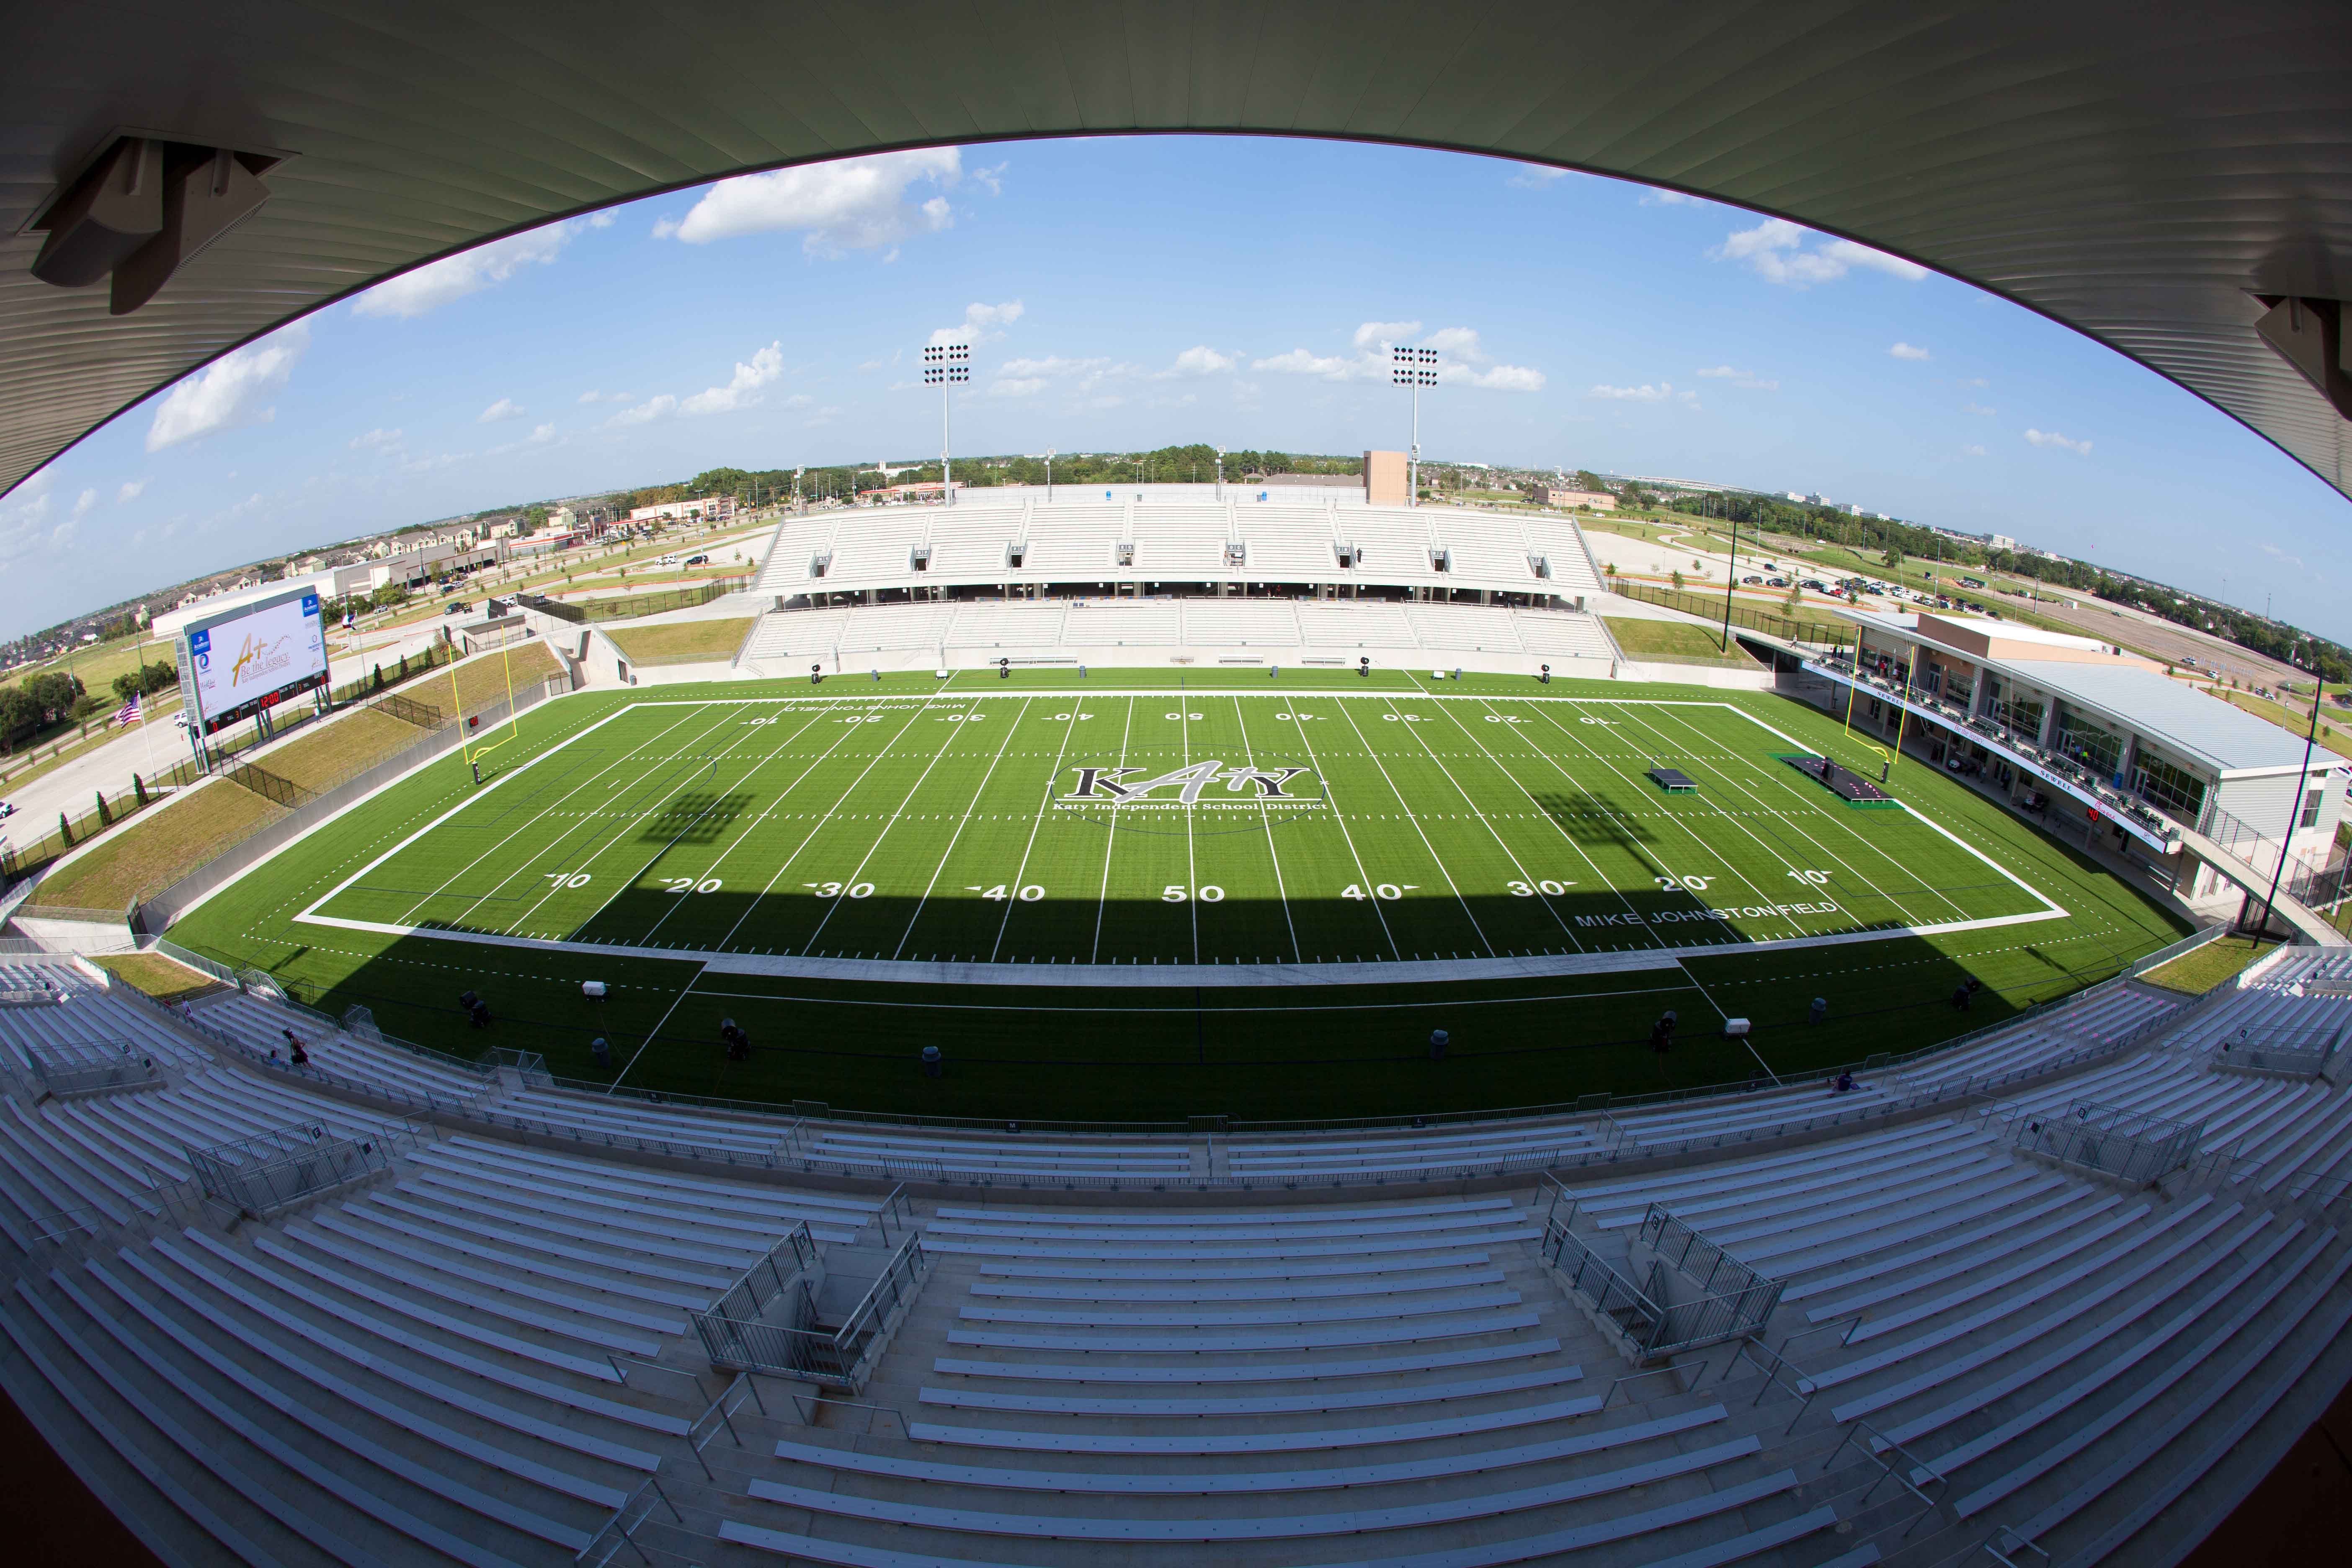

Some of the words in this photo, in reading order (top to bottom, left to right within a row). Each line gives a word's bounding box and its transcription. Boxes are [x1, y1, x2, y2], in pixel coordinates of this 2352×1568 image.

[241, 665, 250, 677] Be
[253, 660, 264, 672] the
[261, 691, 279, 707] 12:00
[1877, 691, 1903, 706] SEWELL
[746, 717, 779, 725] 10
[2040, 770, 2071, 792] SEWELL
[2088, 807, 2099, 821] 40
[551, 873, 591, 888] 10
[1654, 875, 1707, 891] 20
[1787, 870, 1828, 885] 10
[665, 878, 723, 894] 20
[815, 882, 875, 899] 30
[982, 885, 1046, 902] 40
[1161, 885, 1225, 903] 50
[1340, 884, 1402, 901] 40
[1507, 879, 1567, 897] 30
[1575, 913, 1644, 926] MIKE
[1651, 905, 1778, 923] JOHNSTON
[1776, 902, 1837, 915] FIELD
